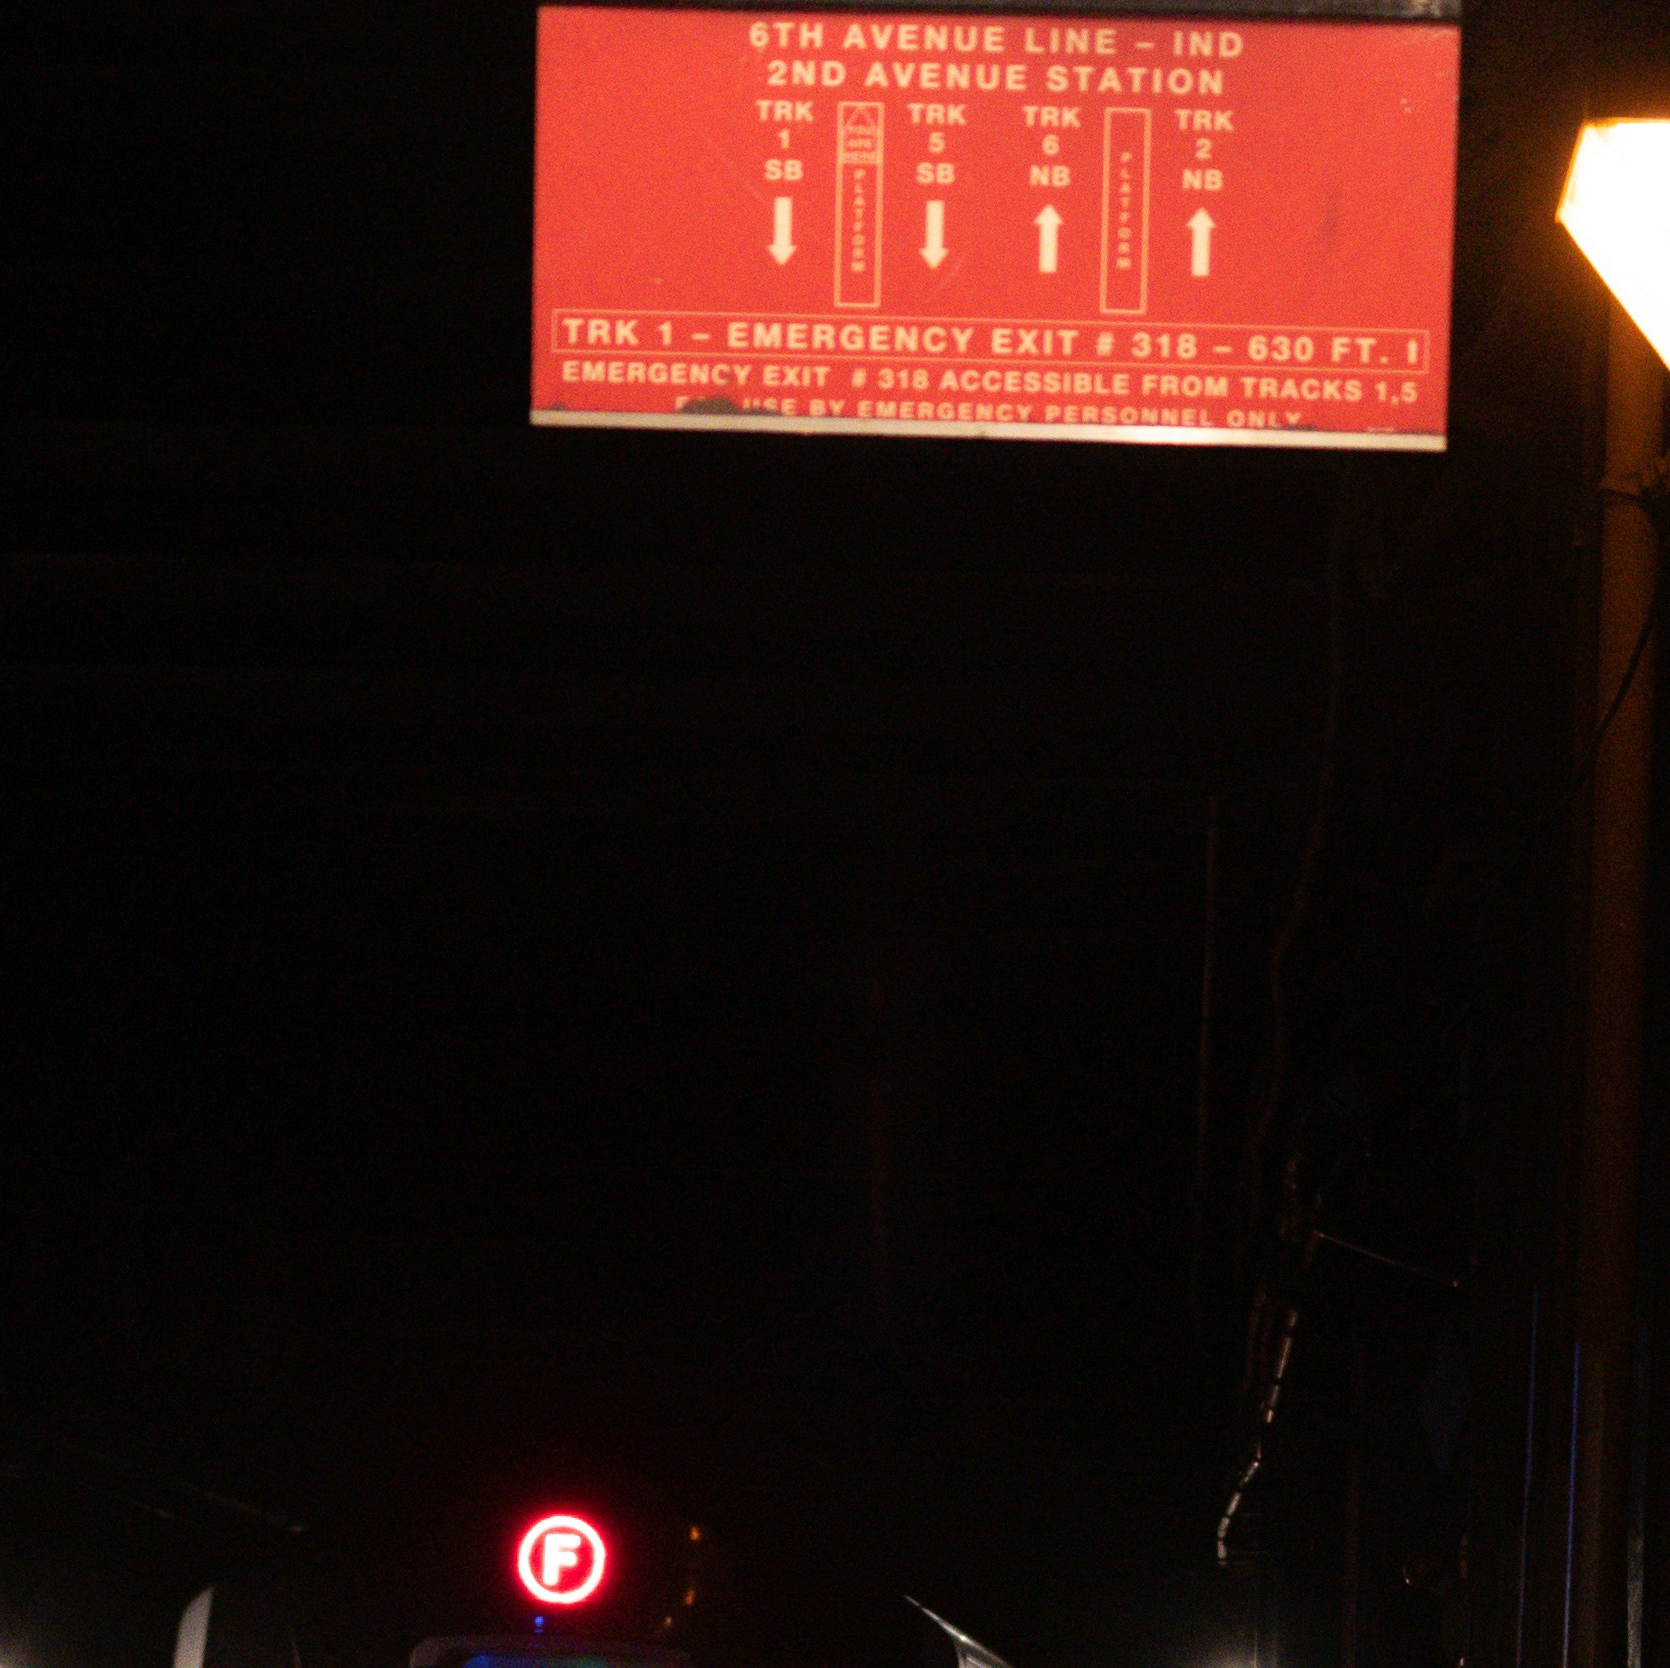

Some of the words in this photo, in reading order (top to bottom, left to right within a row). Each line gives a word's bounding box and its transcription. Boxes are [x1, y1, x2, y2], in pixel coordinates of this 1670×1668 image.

[749, 21, 824, 50] 6TH
[842, 23, 1006, 53] AVENUE
[1024, 27, 1118, 55] LINE
[1173, 30, 1244, 58] IND
[767, 59, 847, 87] 2ND
[864, 61, 1028, 91] AVENUE
[1046, 65, 1224, 95] STATION
[756, 100, 815, 122] TRK
[907, 103, 967, 126] TRK
[1022, 105, 1081, 128] TRK
[1175, 108, 1234, 132] TRK
[777, 129, 790, 150] 1
[928, 131, 945, 154] 5
[1042, 134, 1060, 156] 6
[1195, 137, 1213, 160] 2
[764, 159, 803, 182] SB
[916, 162, 956, 185] SB
[1031, 165, 1071, 188] NB
[1183, 168, 1224, 192] NB
[562, 318, 639, 346] TRK
[658, 321, 673, 346] 1
[727, 322, 974, 353] EMERGENCY
[991, 328, 1079, 356] EXIT
[1096, 331, 1115, 356] #
[1132, 331, 1197, 359] 318
[1248, 335, 1314, 362] 630
[1332, 337, 1389, 364] FT.
[562, 360, 752, 386] EMERGENCY
[762, 365, 830, 388] EXIT
[851, 367, 867, 388] #
[878, 368, 930, 390] 318
[939, 369, 1130, 395] ACCESSIBLE
[1141, 374, 1228, 398] FROM
[1240, 376, 1363, 402] TRACKS
[809, 399, 845, 417] BY
[856, 400, 1034, 422] EMERGENCY
[1044, 404, 1212, 426] PERSONNEL
[1227, 409, 1301, 428] ONLY
[542, 1532, 582, 1587] F
